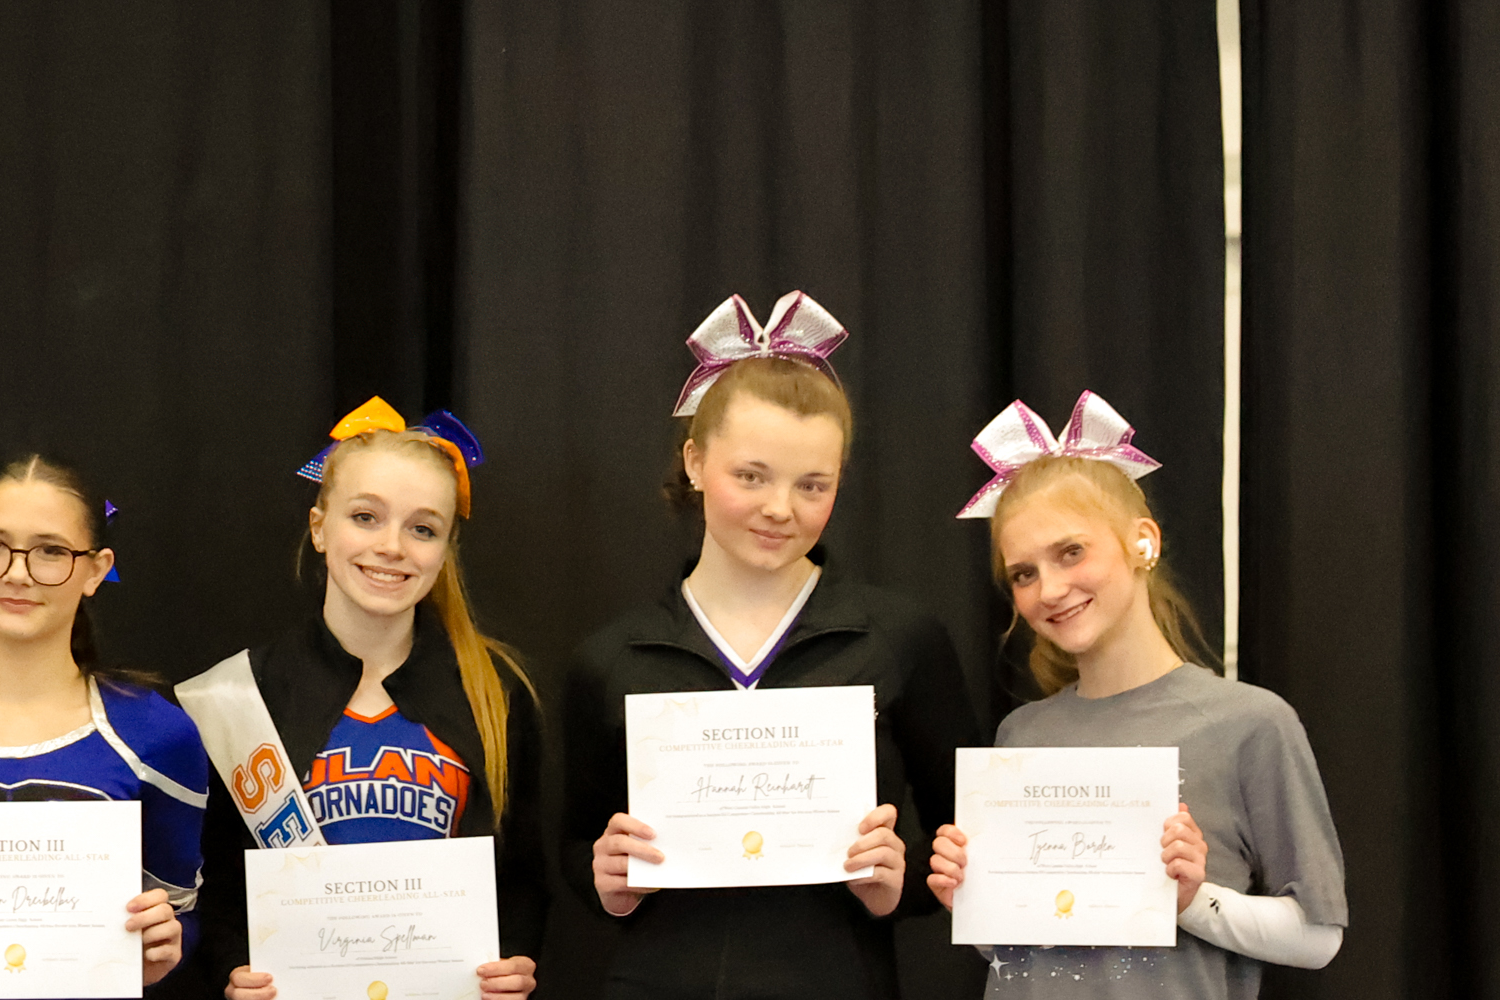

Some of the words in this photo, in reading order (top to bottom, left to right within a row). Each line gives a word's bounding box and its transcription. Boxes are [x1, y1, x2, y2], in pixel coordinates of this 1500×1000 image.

[702, 727, 776, 741] SECTION
[781, 726, 799, 739] III
[659, 742, 723, 753] COMPETITIVE
[724, 740, 796, 750] CHEERLEADING
[799, 739, 844, 748] ALL-STAR
[231, 742, 322, 849] SE
[691, 775, 747, 803] Hannah
[1023, 785, 1090, 798] SECTION
[1095, 785, 1111, 798] III
[308, 782, 452, 830] ORNADOES
[47, 839, 65, 852] III
[65, 853, 110, 861] ALL-STAR
[324, 879, 399, 895] SECTION
[404, 878, 422, 891] III
[281, 896, 345, 906] COMPETITIVE
[347, 892, 420, 903] CHEERLEADING
[422, 890, 467, 900] ALL-STAR
[318, 927, 375, 957] Virginia
[379, 925, 437, 953] Spellman
